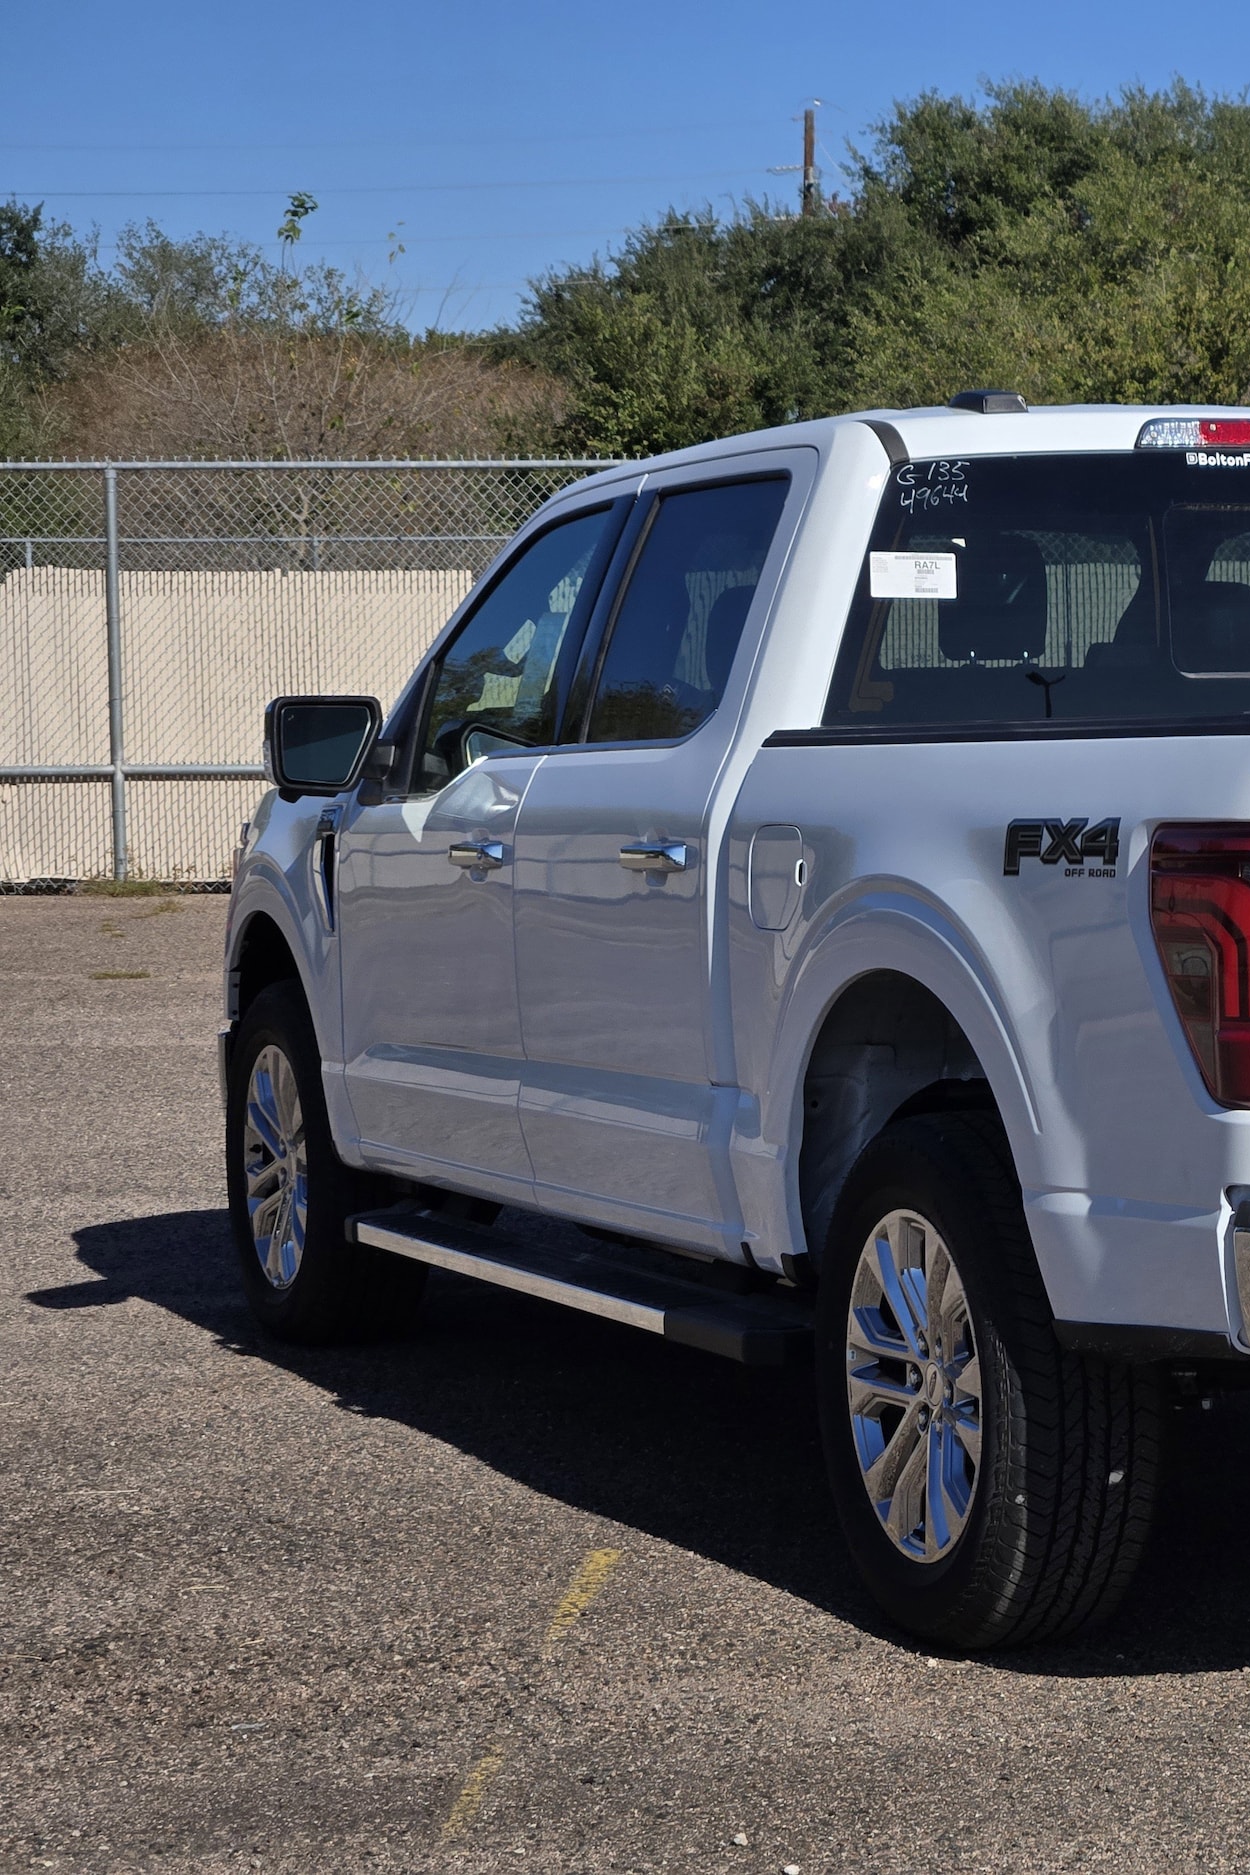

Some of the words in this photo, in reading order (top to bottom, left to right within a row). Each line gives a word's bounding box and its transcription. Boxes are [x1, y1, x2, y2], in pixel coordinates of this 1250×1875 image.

[914, 560, 941, 570] RA7L
[1003, 817, 1121, 876] FX4
[1064, 868, 1085, 878] OFF
[1088, 868, 1116, 878] ROAD
